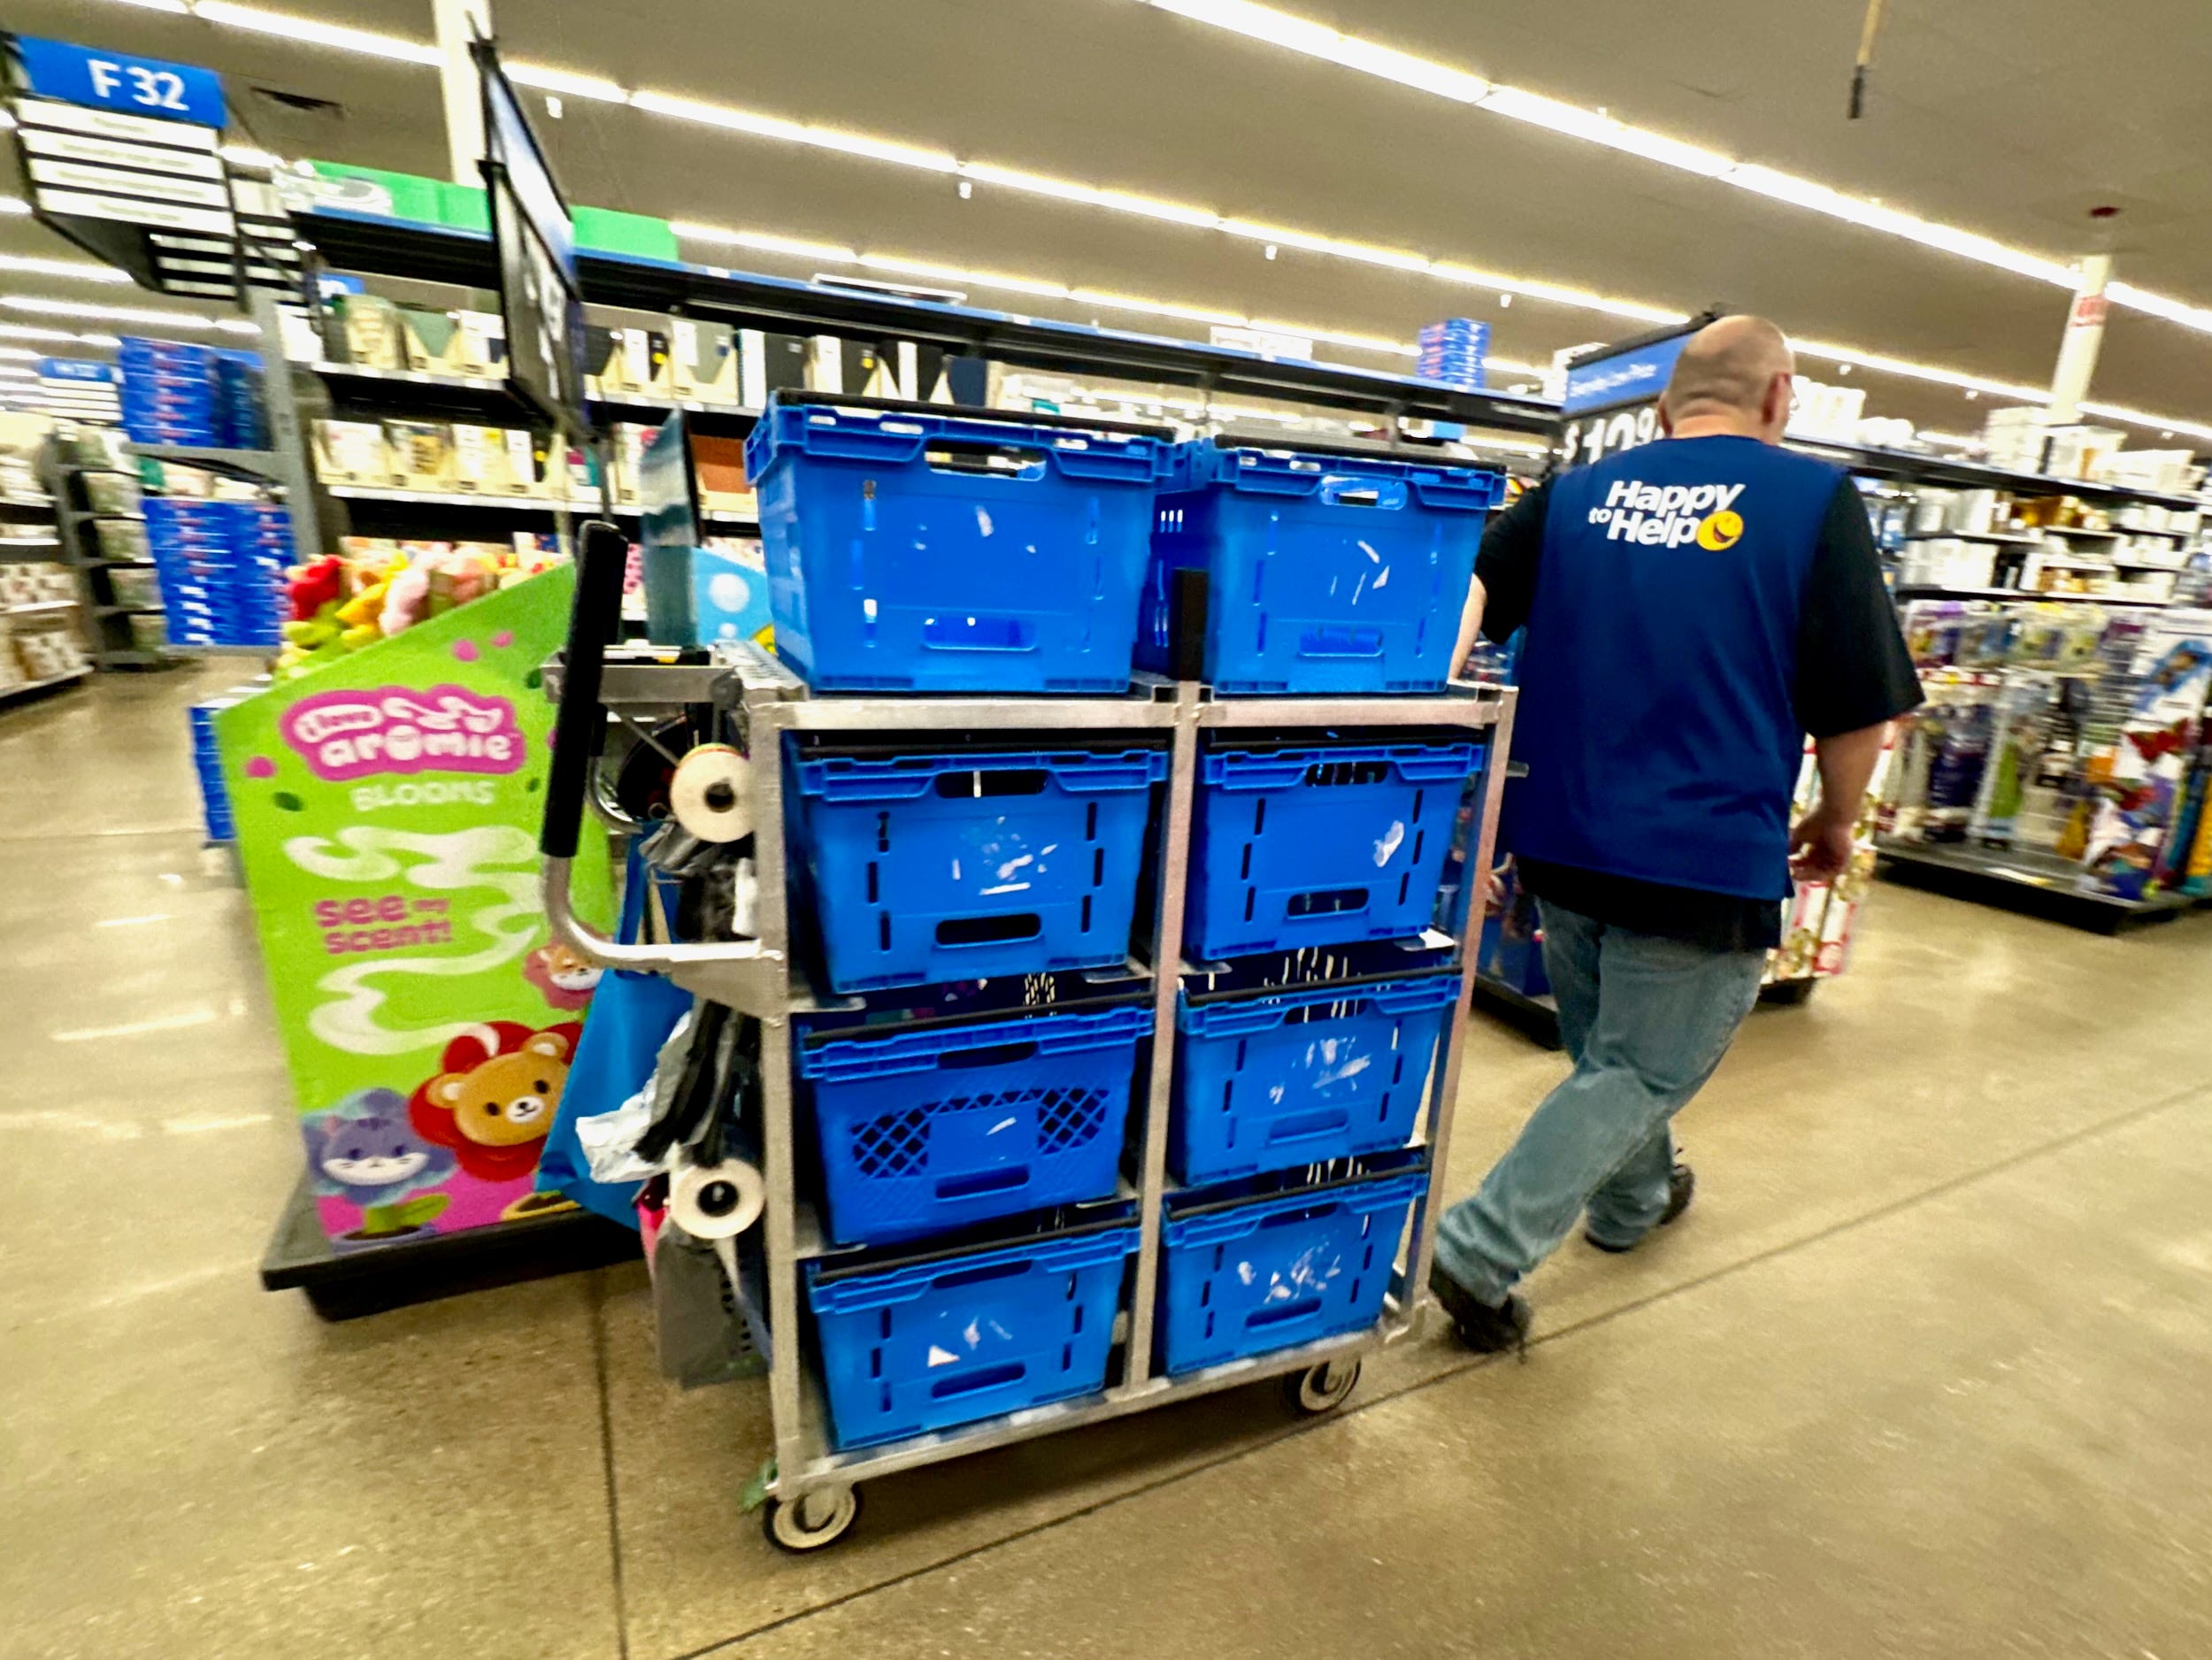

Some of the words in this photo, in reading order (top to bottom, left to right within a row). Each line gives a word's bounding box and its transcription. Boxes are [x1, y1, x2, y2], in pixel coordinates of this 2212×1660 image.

[87, 58, 121, 99] F
[126, 66, 190, 111] 32
[1605, 480, 1746, 516] Happy
[1588, 507, 1612, 524] to
[1607, 509, 1701, 548] Help
[352, 782, 493, 811] BLOOMS
[315, 895, 408, 928] see
[325, 920, 452, 954] scent!
